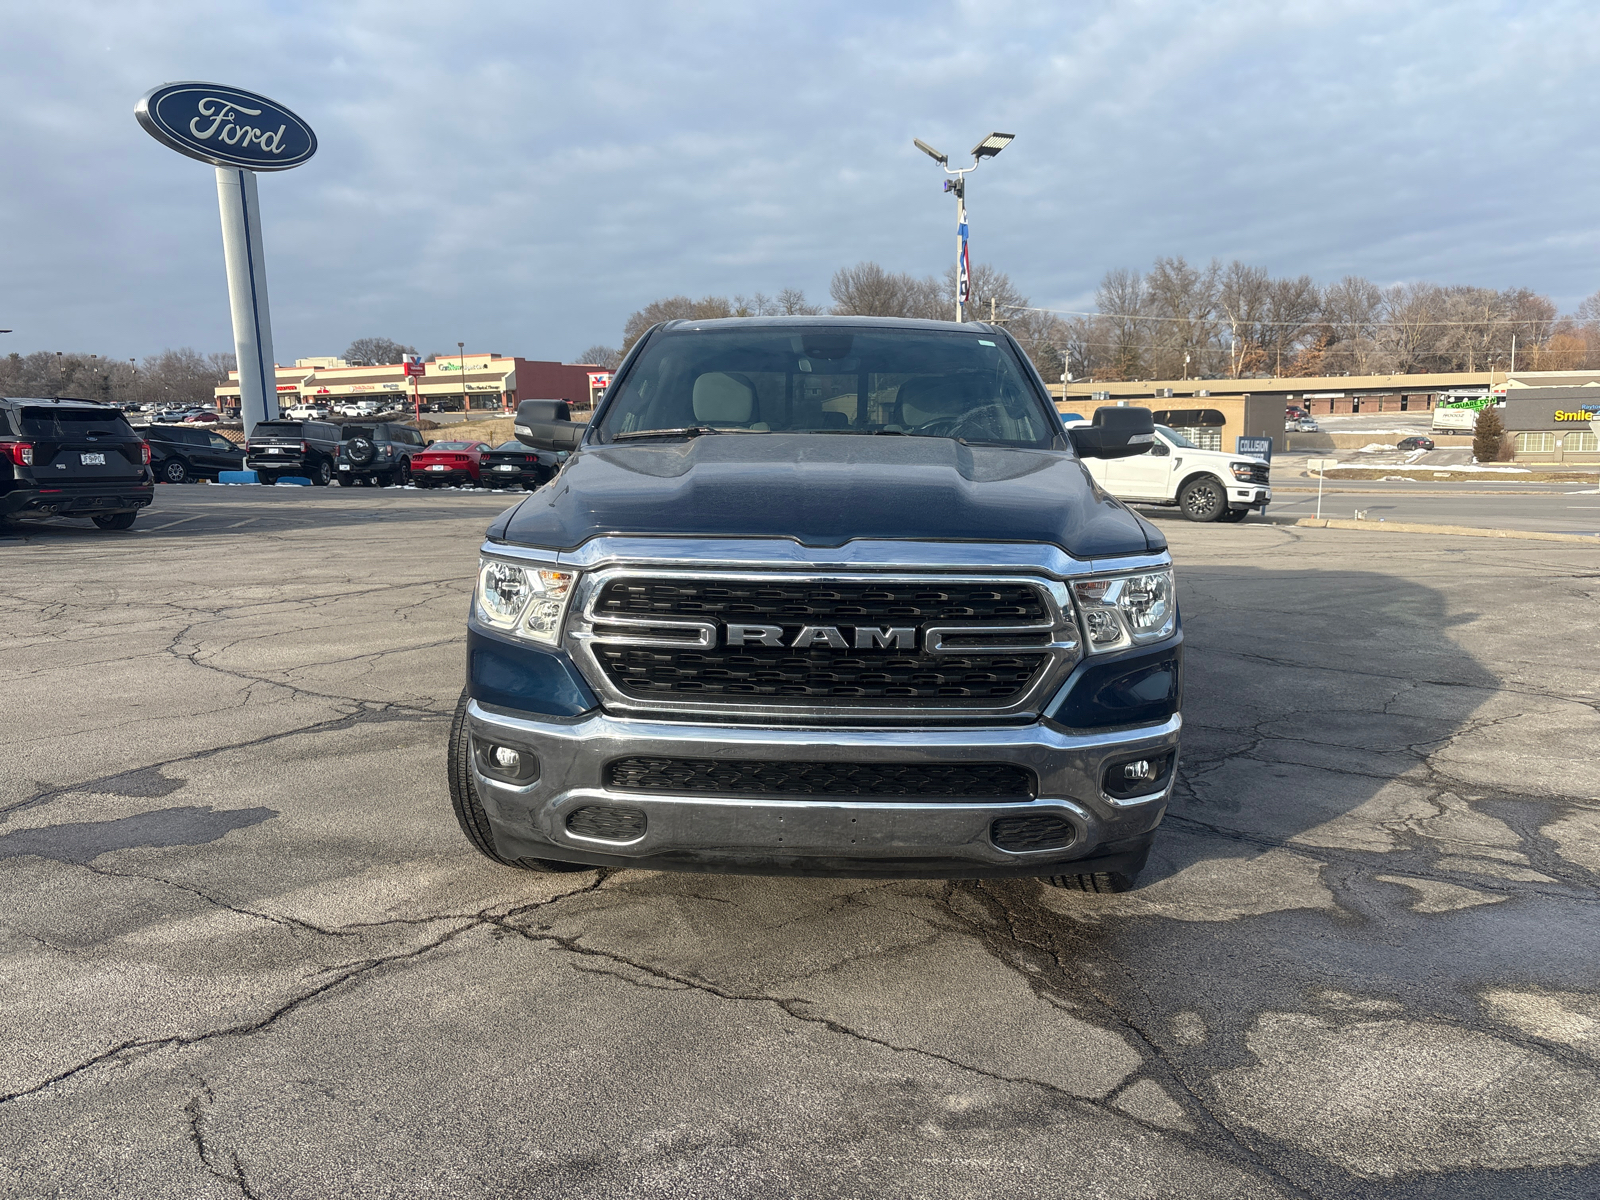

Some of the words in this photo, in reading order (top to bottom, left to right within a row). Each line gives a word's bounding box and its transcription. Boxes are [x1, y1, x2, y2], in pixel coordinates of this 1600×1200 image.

[190, 97, 287, 154] Ford
[1451, 401, 1478, 409] SQUARE
[1240, 440, 1268, 451] COLLISION
[726, 623, 916, 648] RAM
